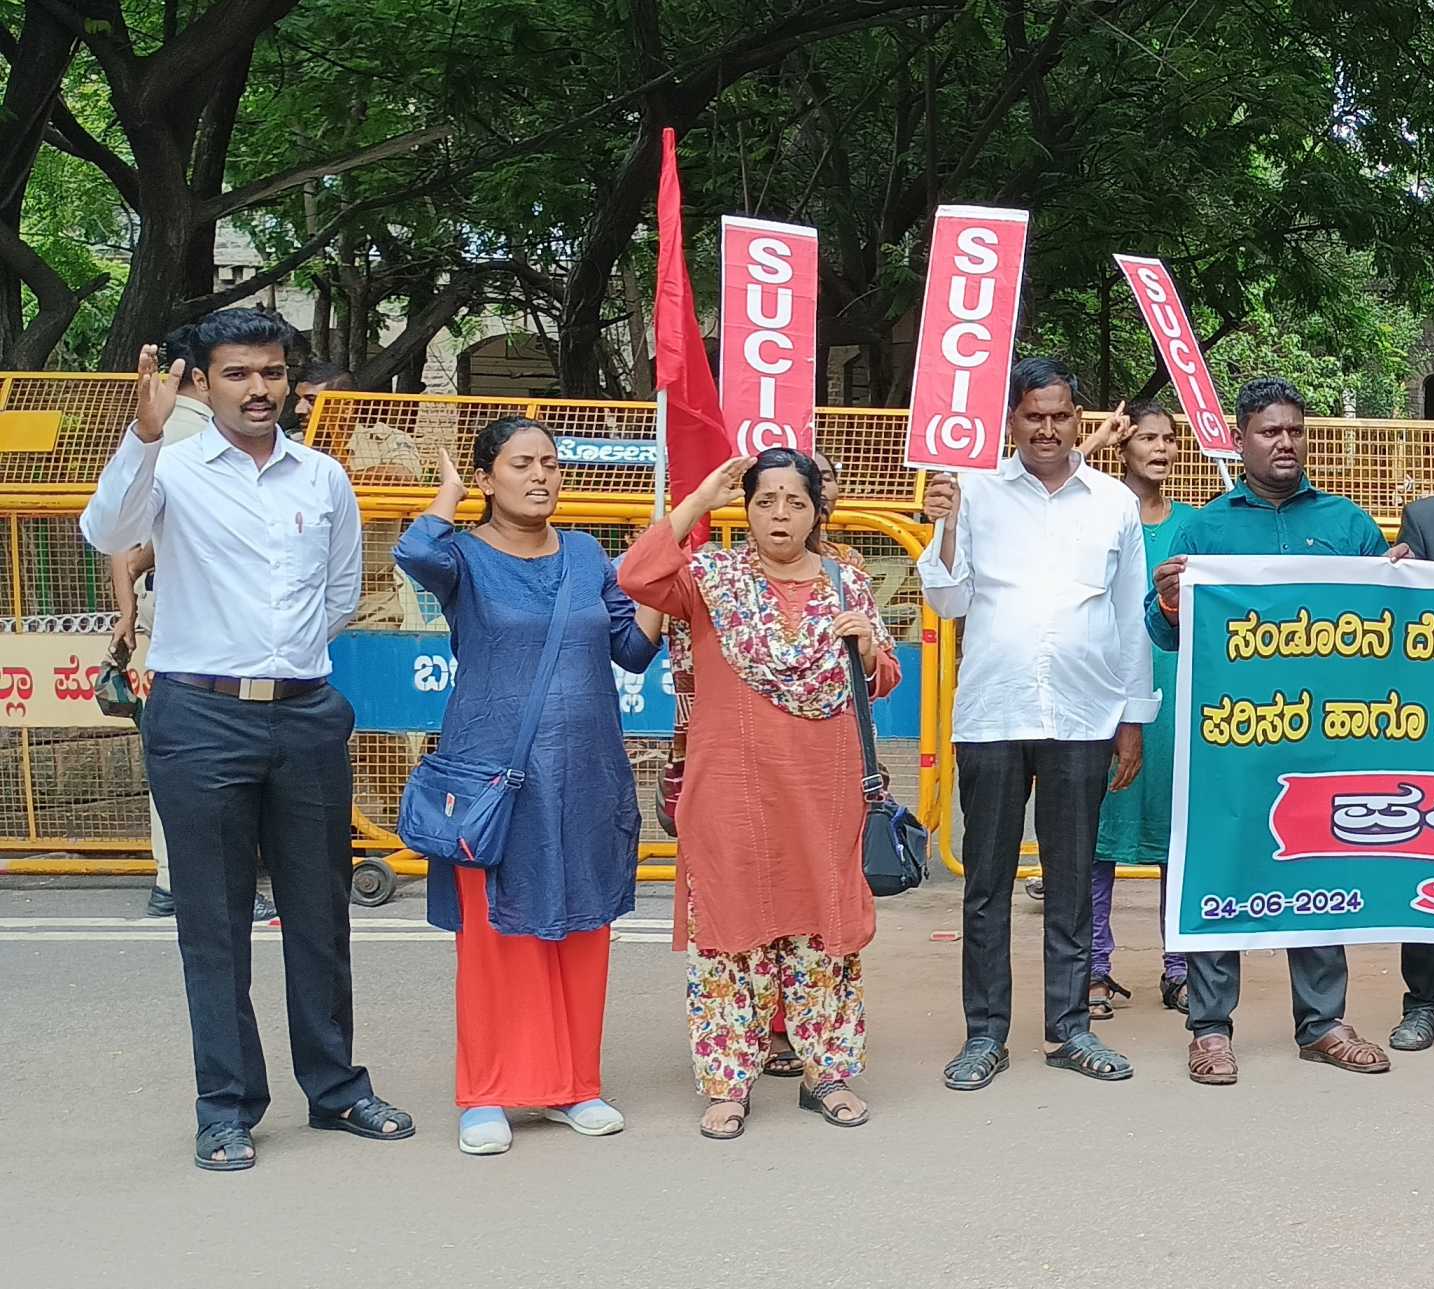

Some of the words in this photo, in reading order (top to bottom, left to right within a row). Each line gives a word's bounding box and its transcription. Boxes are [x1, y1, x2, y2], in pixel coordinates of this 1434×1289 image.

[743, 237, 793, 419] SUCI
[941, 227, 999, 413] SUCI
[1137, 268, 1207, 409] SUCI
[1196, 409, 1228, 444] (C)
[925, 414, 986, 459] (C)
[1228, 609, 1393, 661] ಸಂಡೂರಿನ
[1201, 690, 1312, 745] ಪರಿಸರ
[1323, 690, 1428, 741] ಹಾಗೂ
[1202, 889, 1363, 919] 24-06-2024
